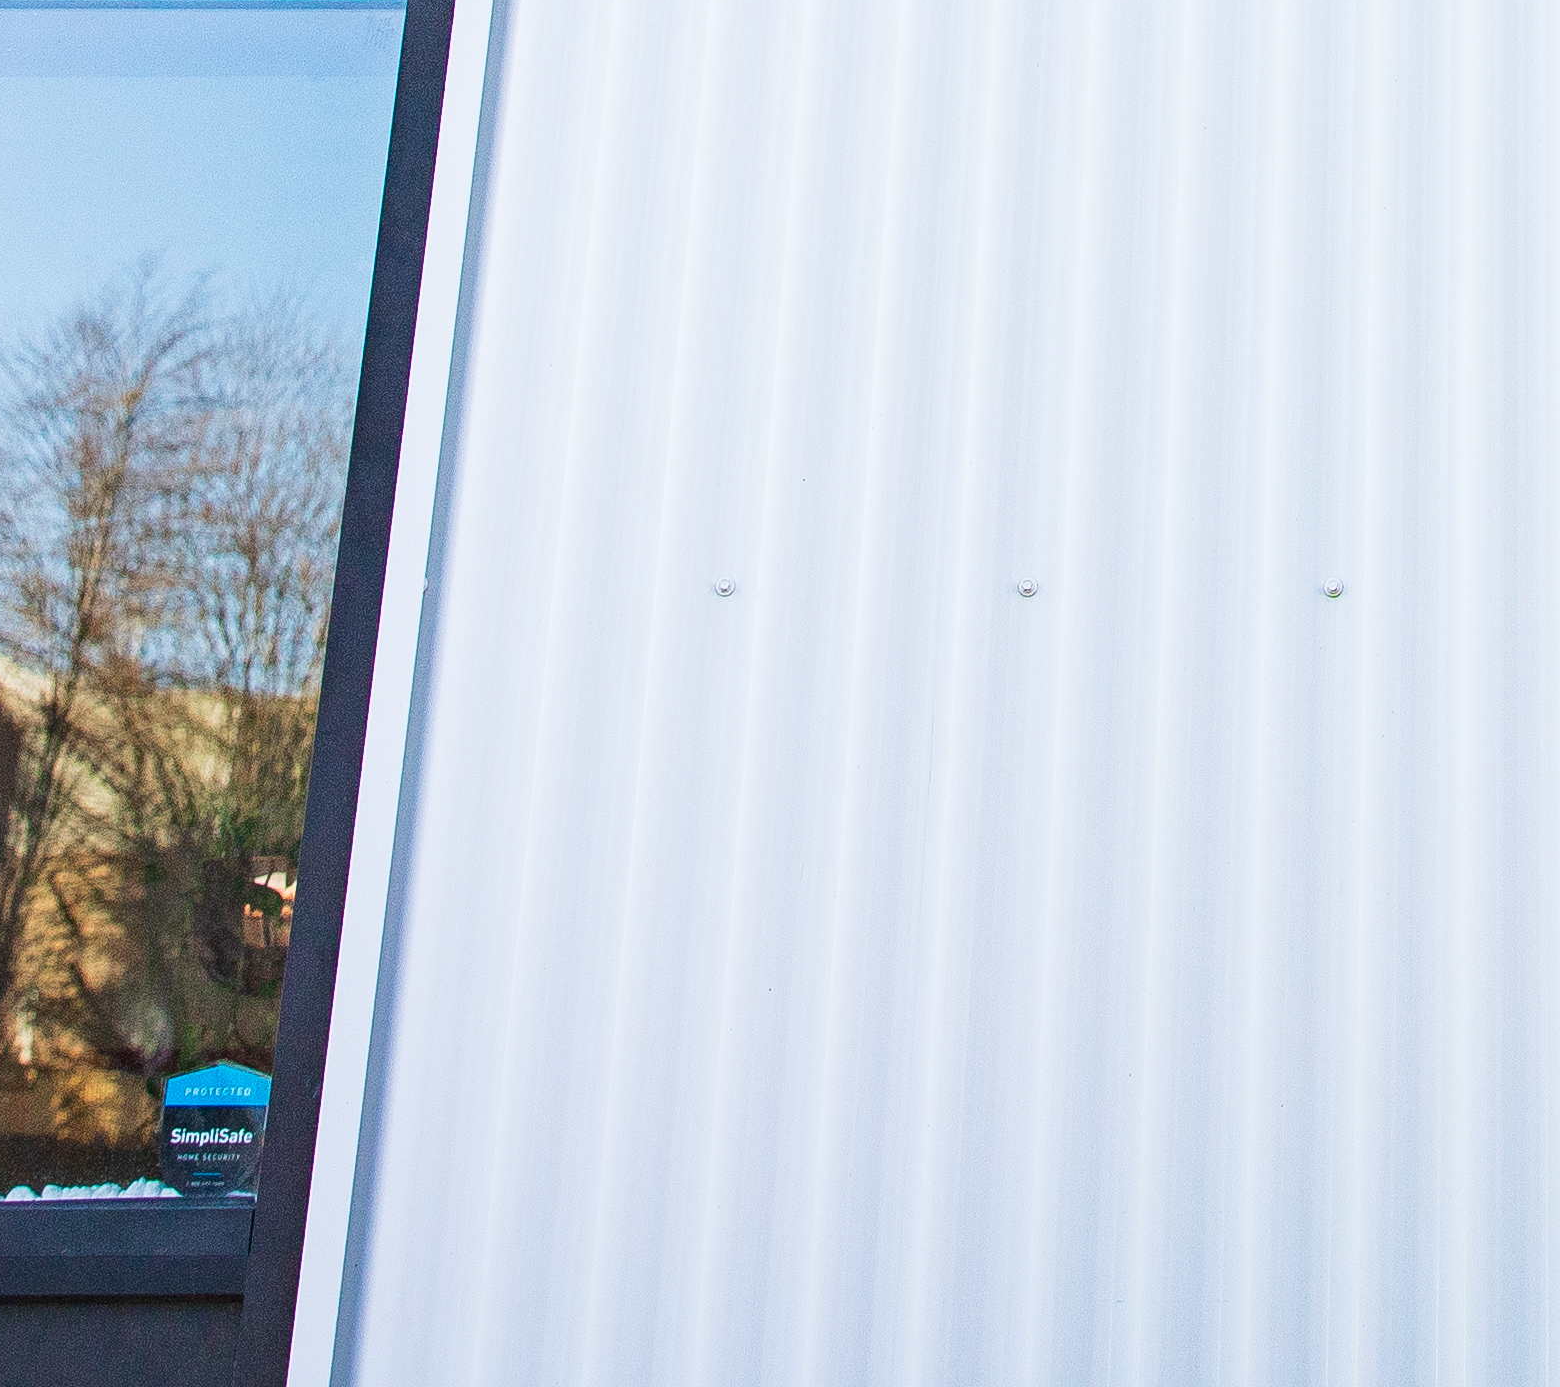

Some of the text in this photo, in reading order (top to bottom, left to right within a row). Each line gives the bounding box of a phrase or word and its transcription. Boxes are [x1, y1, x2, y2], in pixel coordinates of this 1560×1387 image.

[185, 1087, 252, 1096] PROTECTED
[170, 1128, 253, 1146] SimpliSafe
[177, 1153, 241, 1161] HOME SECURITY
